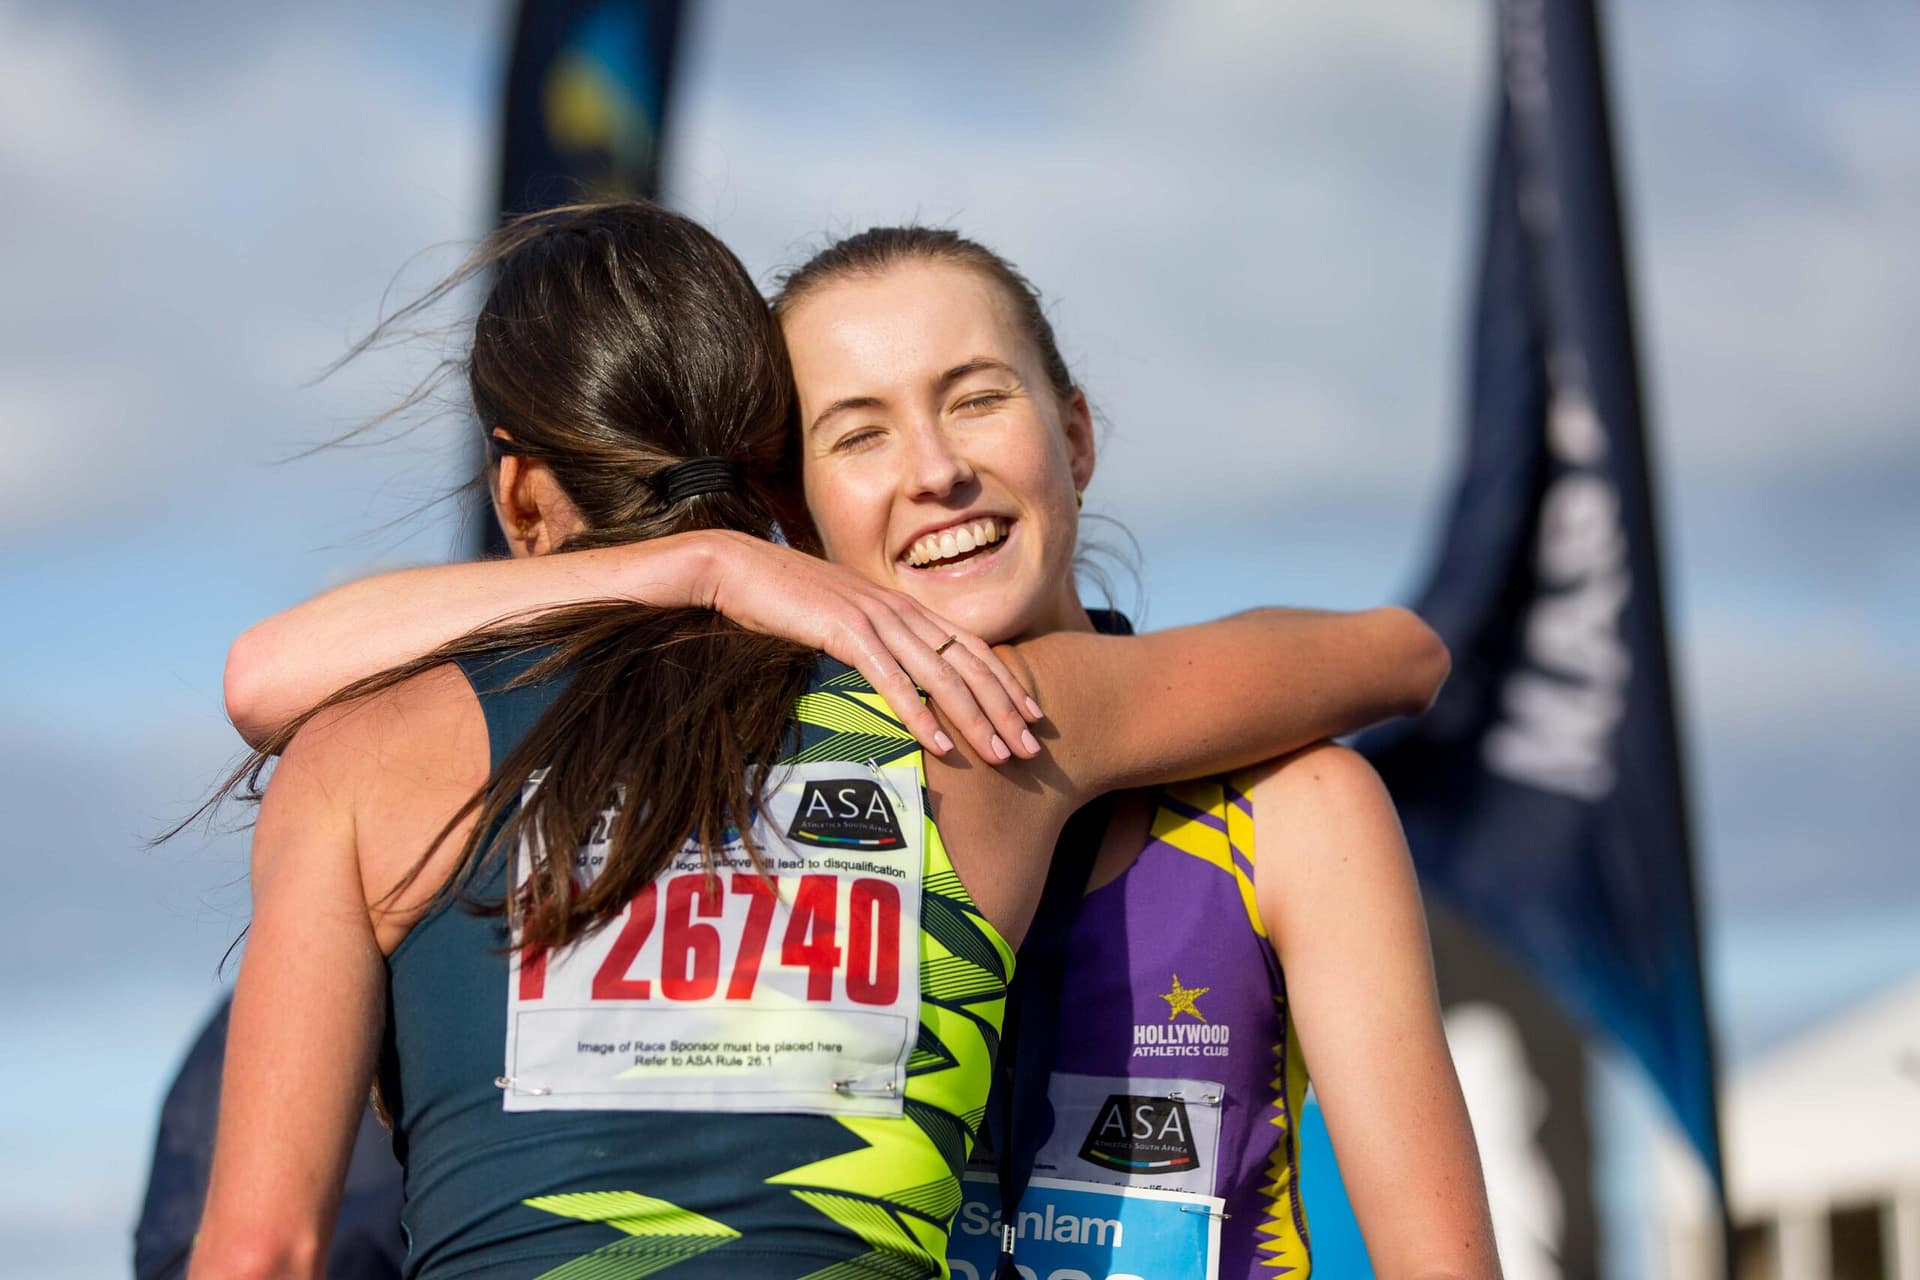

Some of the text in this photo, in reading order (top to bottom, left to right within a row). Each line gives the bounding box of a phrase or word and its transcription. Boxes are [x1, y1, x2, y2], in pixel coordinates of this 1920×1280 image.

[806, 788, 889, 823] ASA
[778, 858, 804, 869] lead
[808, 859, 820, 869] to
[824, 858, 907, 878] disqualification
[591, 873, 901, 1007] 26740
[1133, 1024, 1230, 1045] HOLLYWOOD
[577, 1039, 843, 1055] Image of Race Sponsor must be placed here
[1132, 1046, 1229, 1057] ATHLETICS CLUB
[634, 1054, 772, 1066] Refer to ASA Rule 26.1
[1100, 1103, 1185, 1142] ASA
